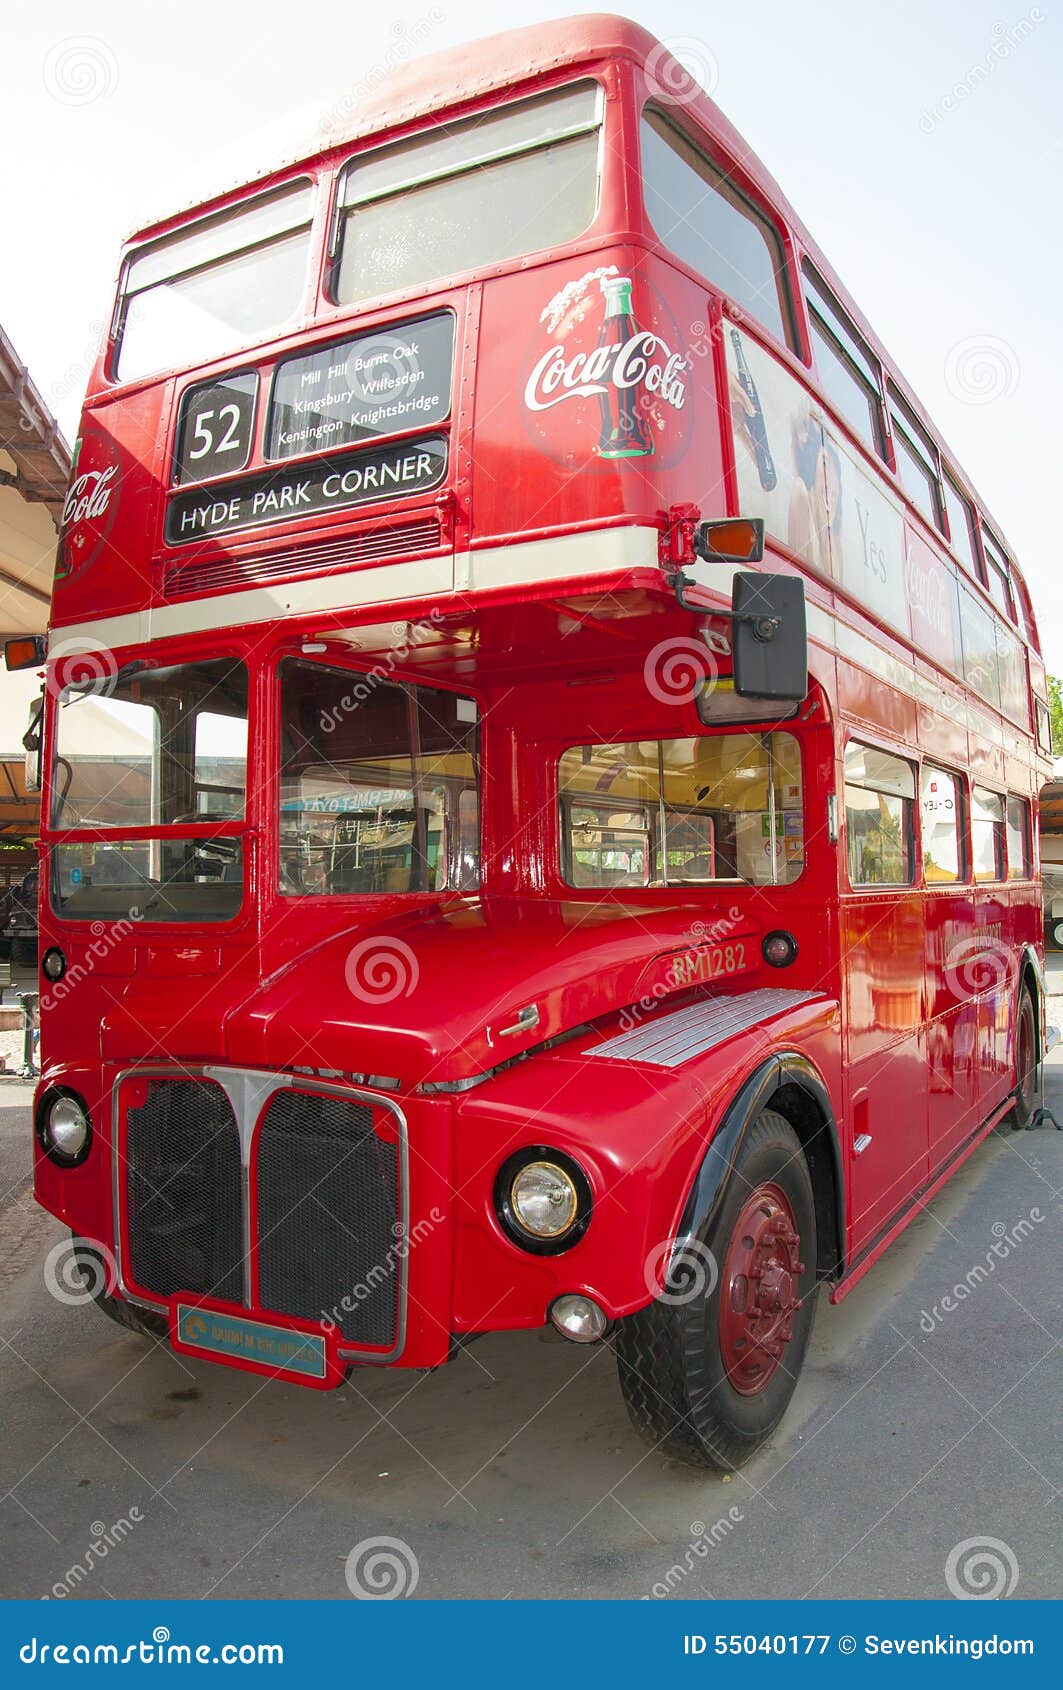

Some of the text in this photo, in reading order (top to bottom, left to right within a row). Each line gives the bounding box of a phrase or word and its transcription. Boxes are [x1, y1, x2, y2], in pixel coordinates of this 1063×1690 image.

[301, 343, 419, 388] Mill Hill Burnt Oak
[524, 331, 688, 411] Coca-Cola
[294, 370, 425, 415] Kingsbury Willesden
[189, 404, 241, 459] 52
[278, 394, 440, 446] Kensington Knightsbridge
[181, 453, 433, 532] HYDE PARK CORNER
[855, 499, 887, 584] Yes
[672, 943, 746, 986] RM1282
